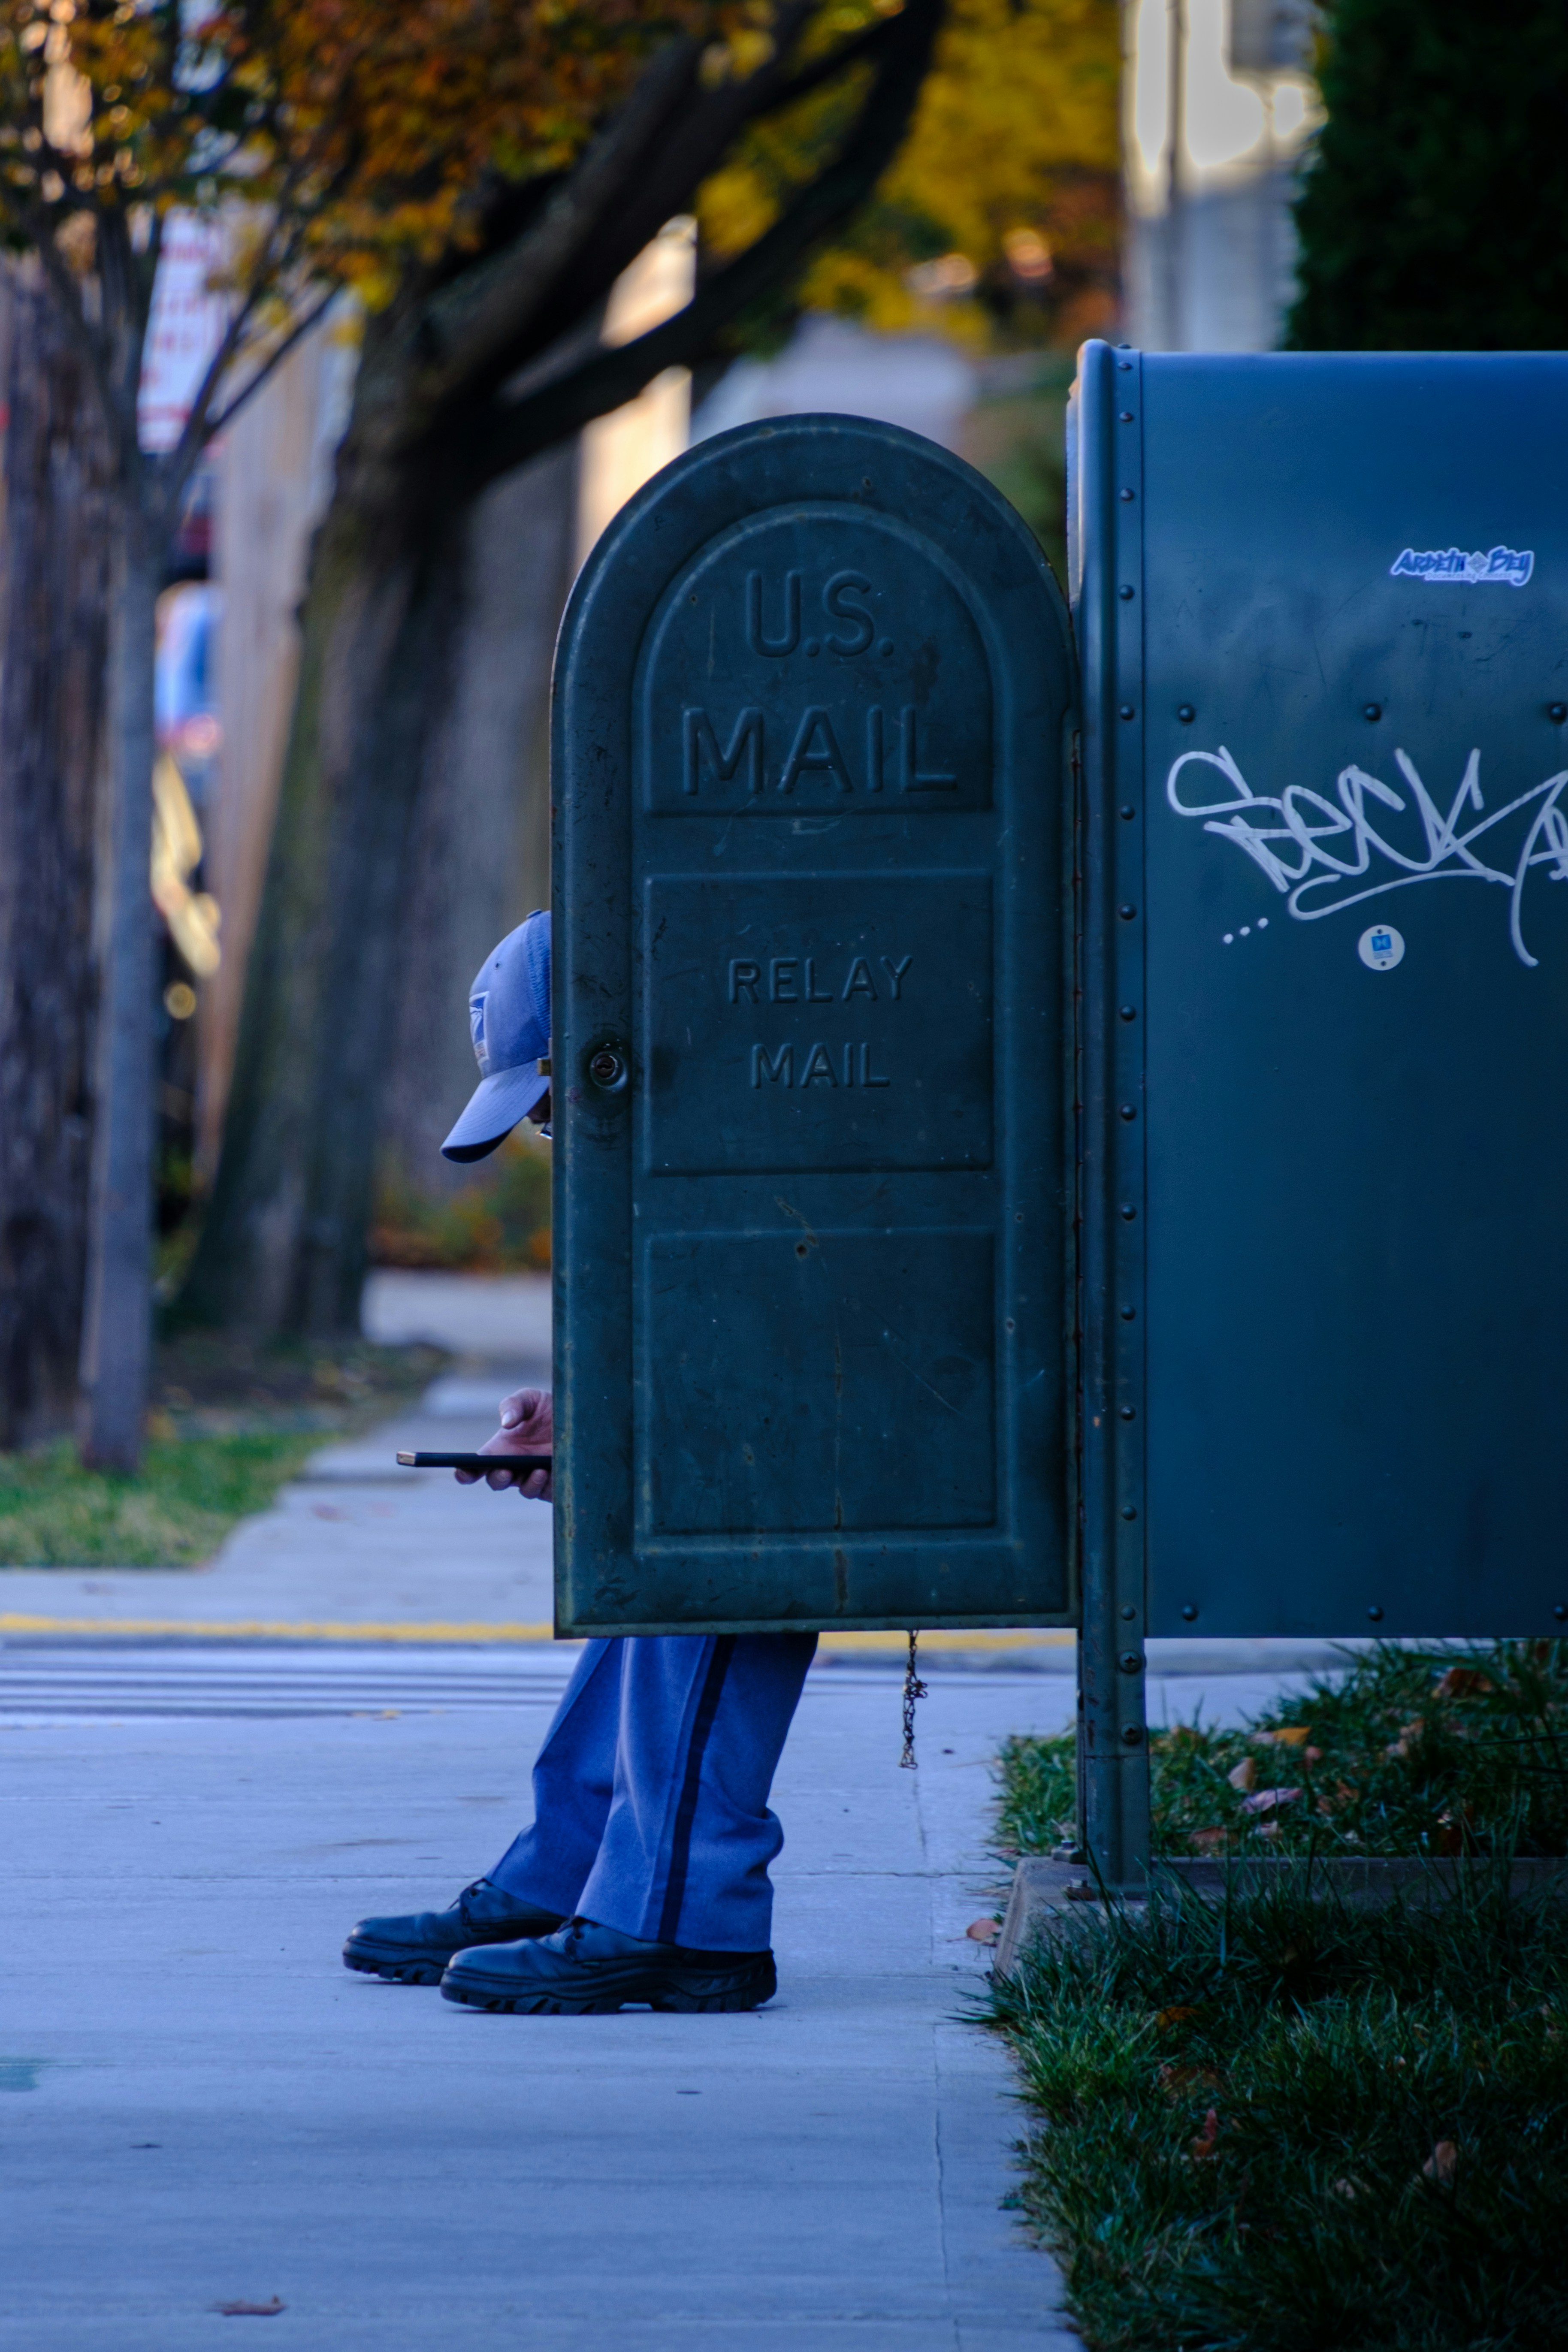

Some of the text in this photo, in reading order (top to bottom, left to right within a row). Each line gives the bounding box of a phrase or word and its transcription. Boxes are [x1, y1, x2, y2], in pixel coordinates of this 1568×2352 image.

[745, 569, 894, 658] U.S.
[682, 705, 958, 795] MAIL
[729, 955, 913, 1004] RELAY
[751, 1042, 891, 1089] MAIL
